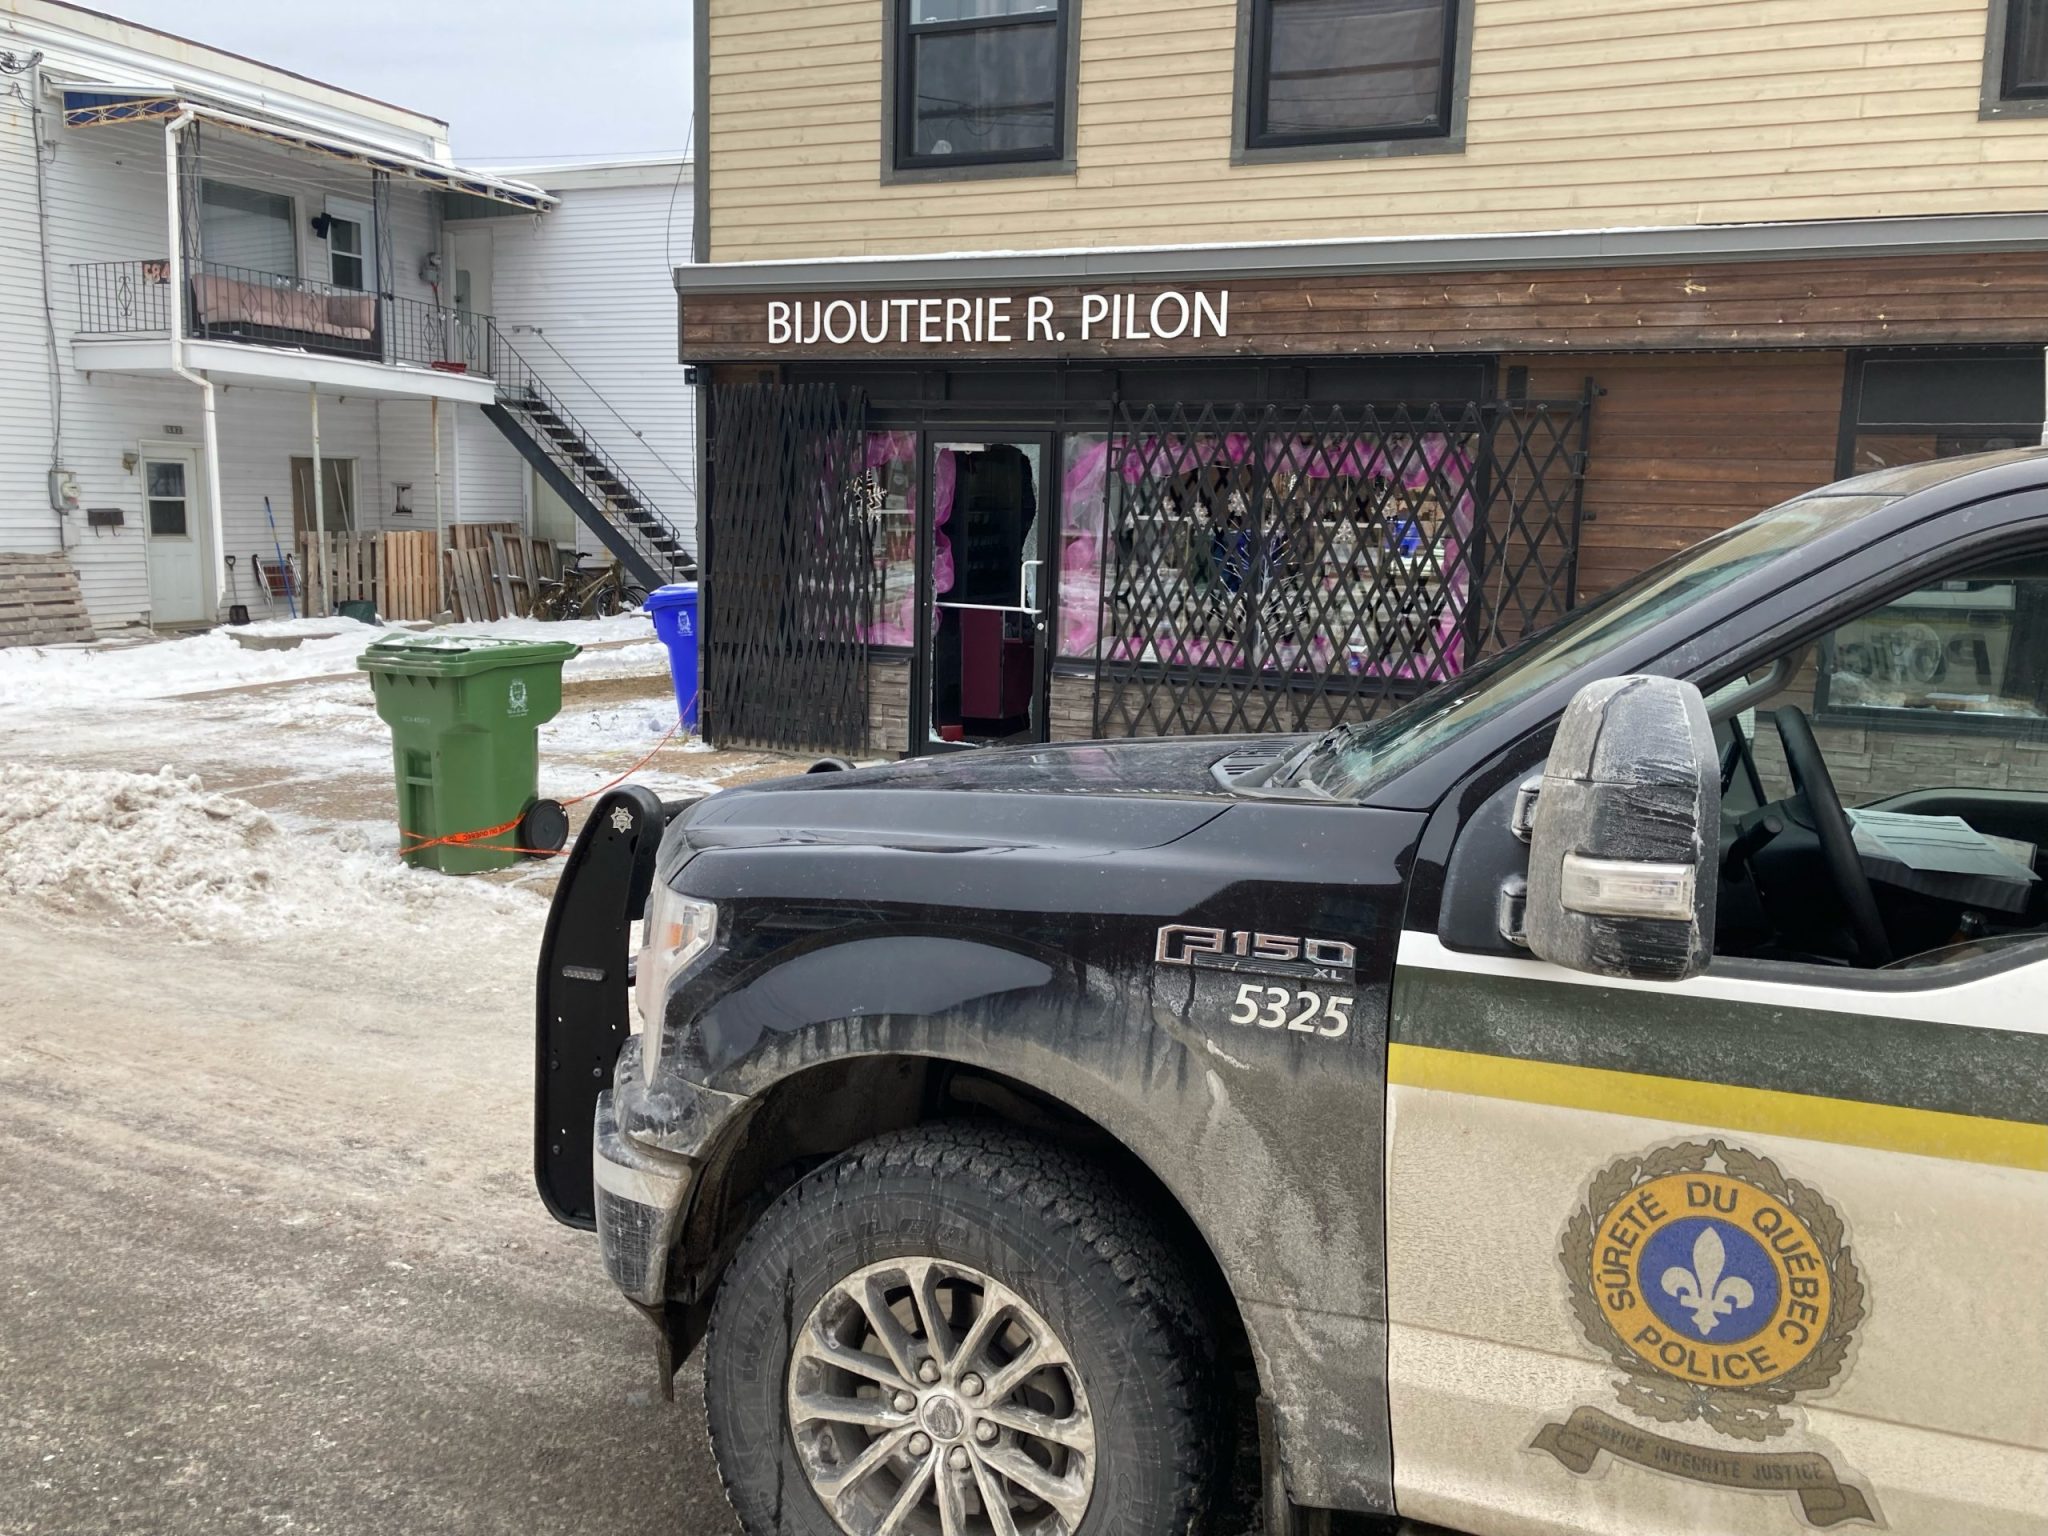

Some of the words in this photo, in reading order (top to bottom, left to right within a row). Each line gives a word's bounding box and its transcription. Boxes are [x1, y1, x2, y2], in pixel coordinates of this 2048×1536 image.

[767, 297, 1012, 345] BIJOUTERIE
[1027, 295, 1066, 343] R.
[1081, 290, 1229, 342] PILON
[1312, 967, 1344, 981] XL
[1230, 983, 1354, 1038] 5325
[1597, 1190, 1668, 1312] SÛRETÉ
[1686, 1181, 1739, 1214] DU
[1752, 1206, 1820, 1347] QUÉBEC
[1633, 1324, 1779, 1381] POLICE
[1752, 1462, 1826, 1482] JUSTICE
